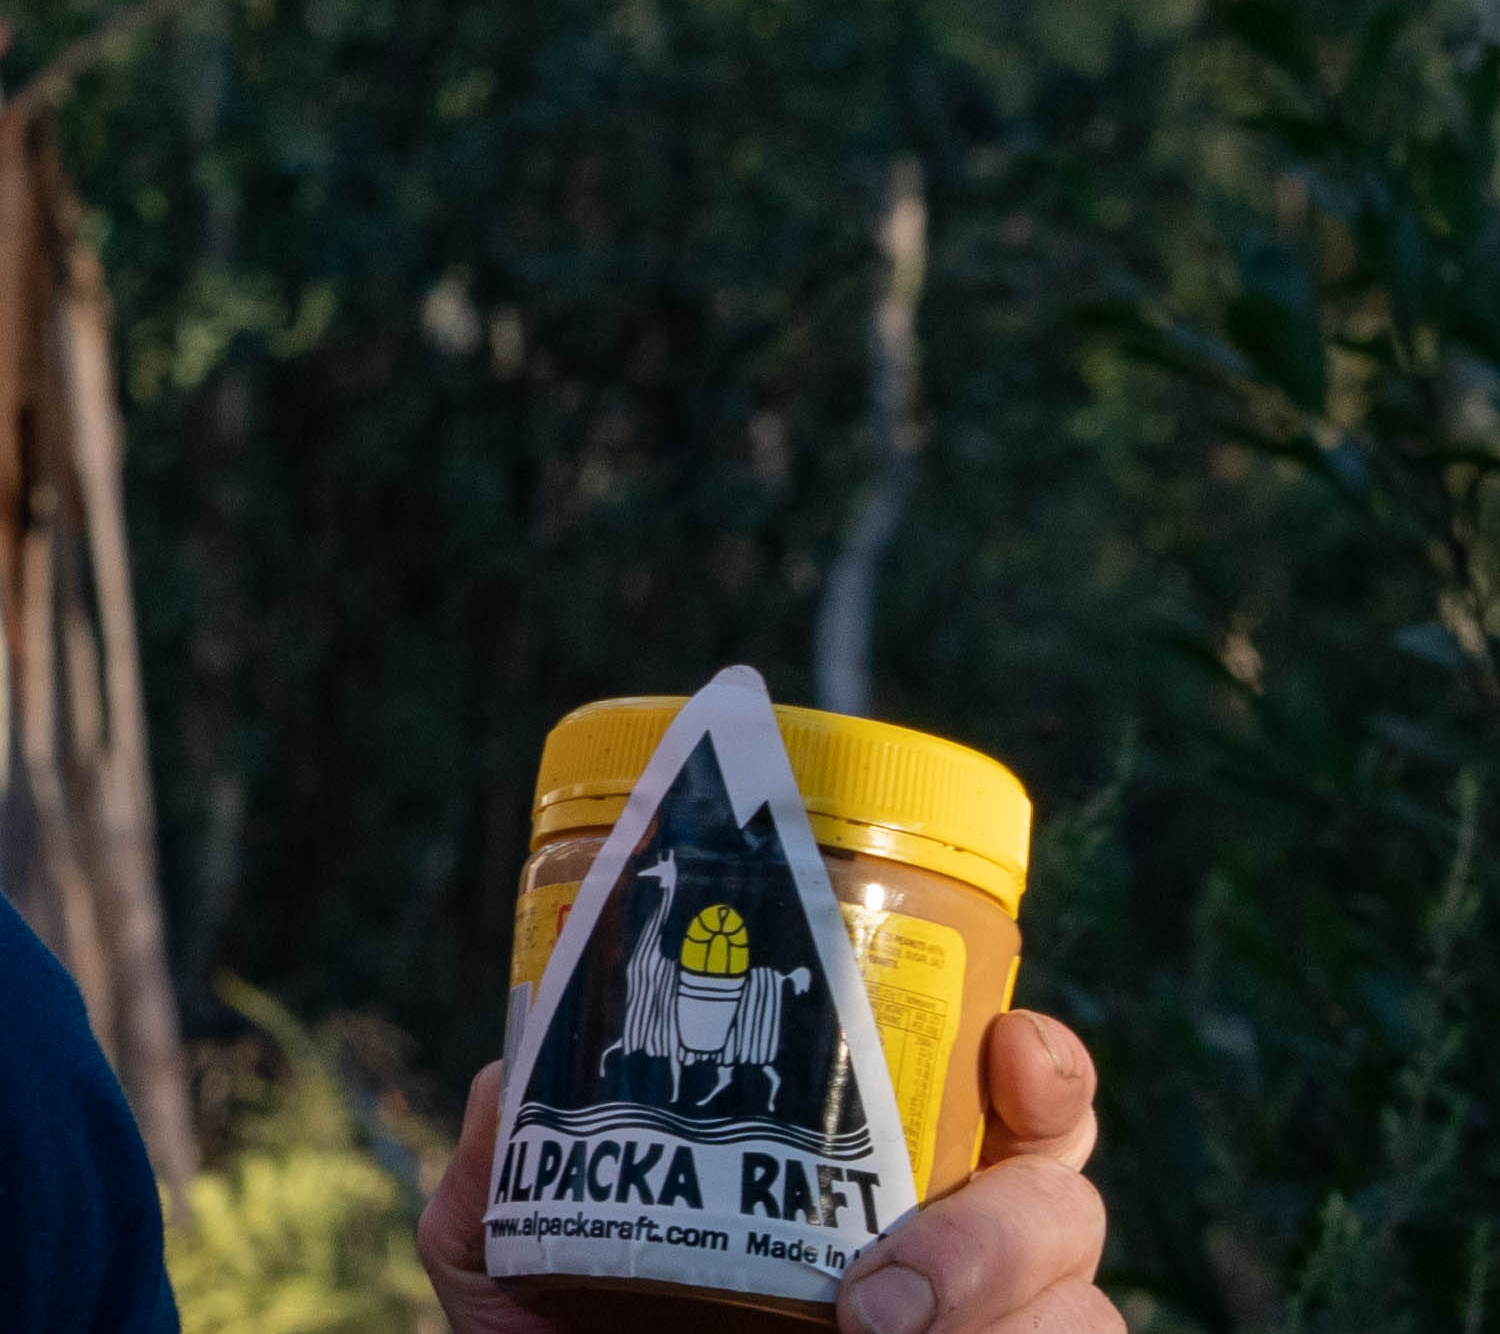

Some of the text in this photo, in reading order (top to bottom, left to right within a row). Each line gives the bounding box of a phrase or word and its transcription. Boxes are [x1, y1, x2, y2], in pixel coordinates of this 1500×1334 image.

[495, 1140, 880, 1234] ALPACKA RAFT
[490, 1211, 846, 1269] www.alpackaraft.com Made in
